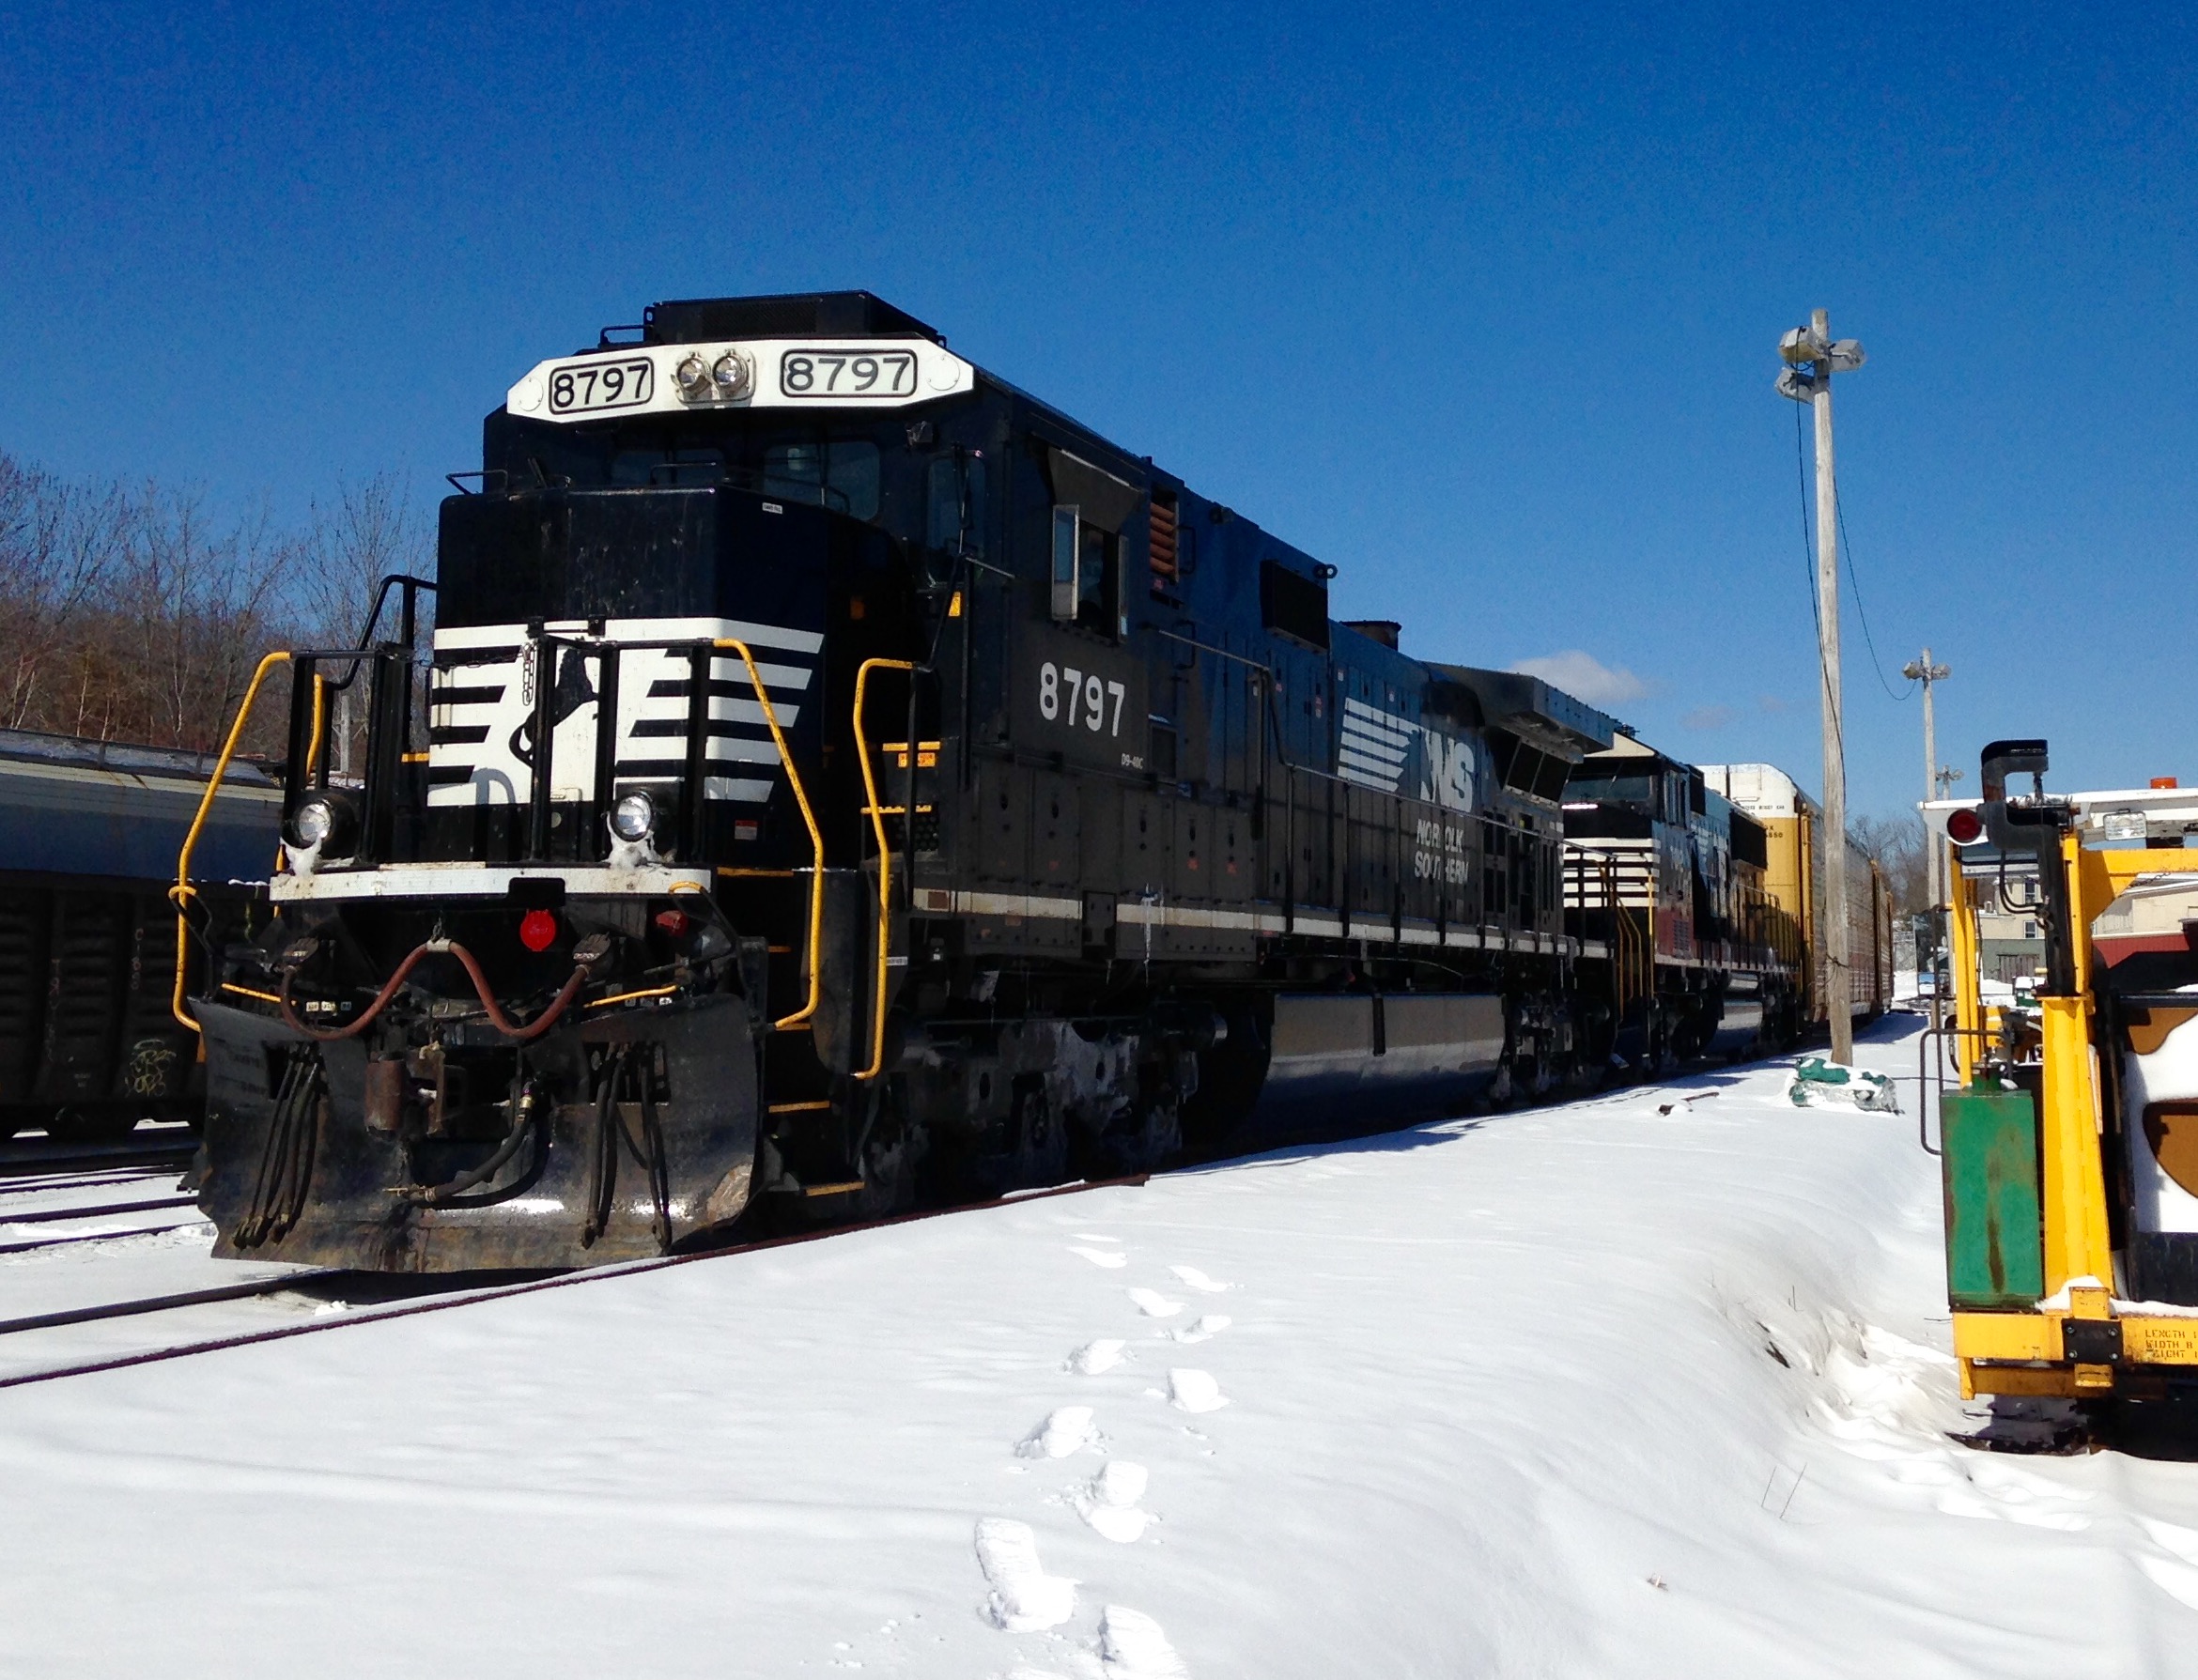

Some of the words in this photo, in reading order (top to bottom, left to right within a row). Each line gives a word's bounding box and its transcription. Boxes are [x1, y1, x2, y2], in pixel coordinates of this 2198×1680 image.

[553, 364, 649, 408] 8797
[786, 357, 911, 392] 8797
[1040, 662, 1125, 736] 8797
[1416, 818, 1464, 853] NOROLK
